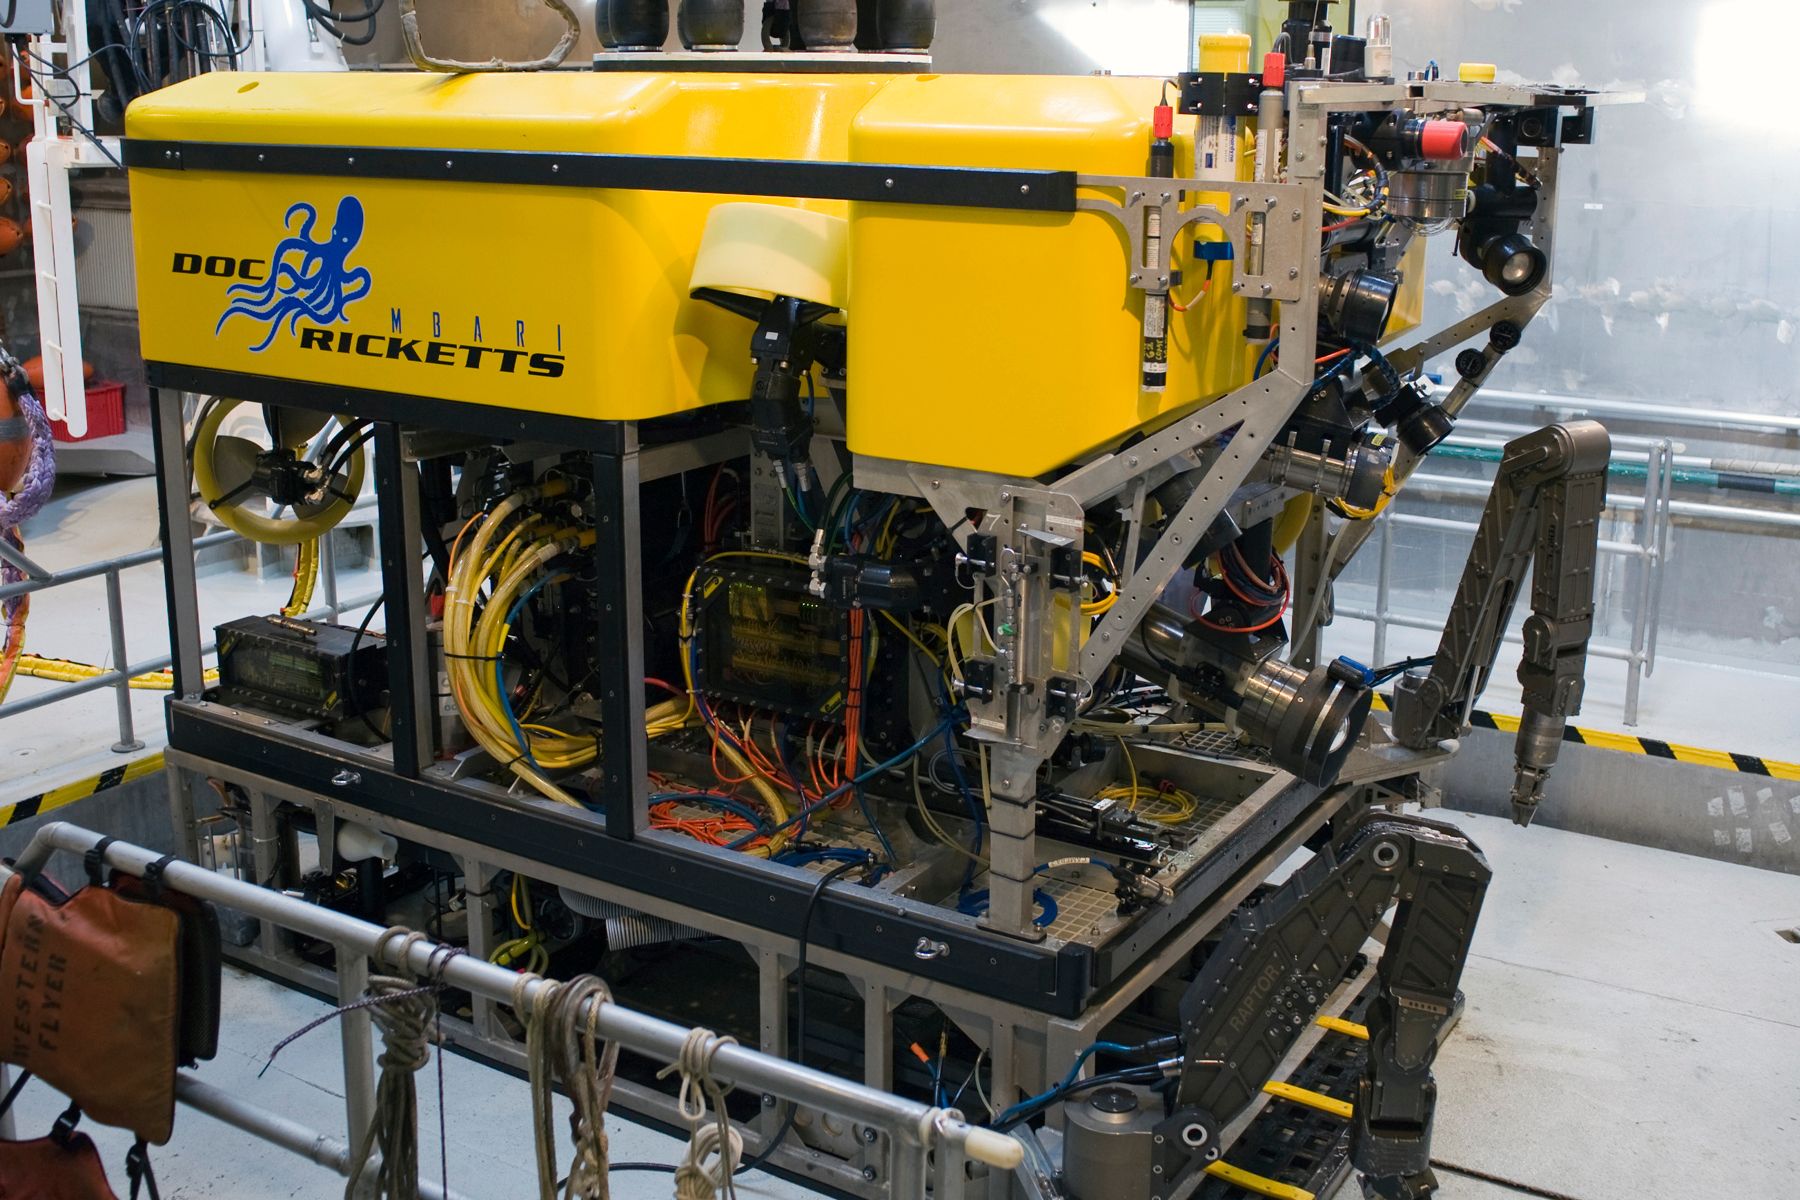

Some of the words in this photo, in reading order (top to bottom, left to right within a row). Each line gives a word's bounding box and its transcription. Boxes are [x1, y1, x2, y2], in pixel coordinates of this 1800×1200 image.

[172, 253, 265, 280] DOC
[300, 327, 566, 378] RICKETTS
[391, 308, 561, 352] MBARI
[13, 914, 44, 1057] WESTERN
[39, 955, 67, 1051] FLYER
[1232, 965, 1279, 1031] RAPTOR
